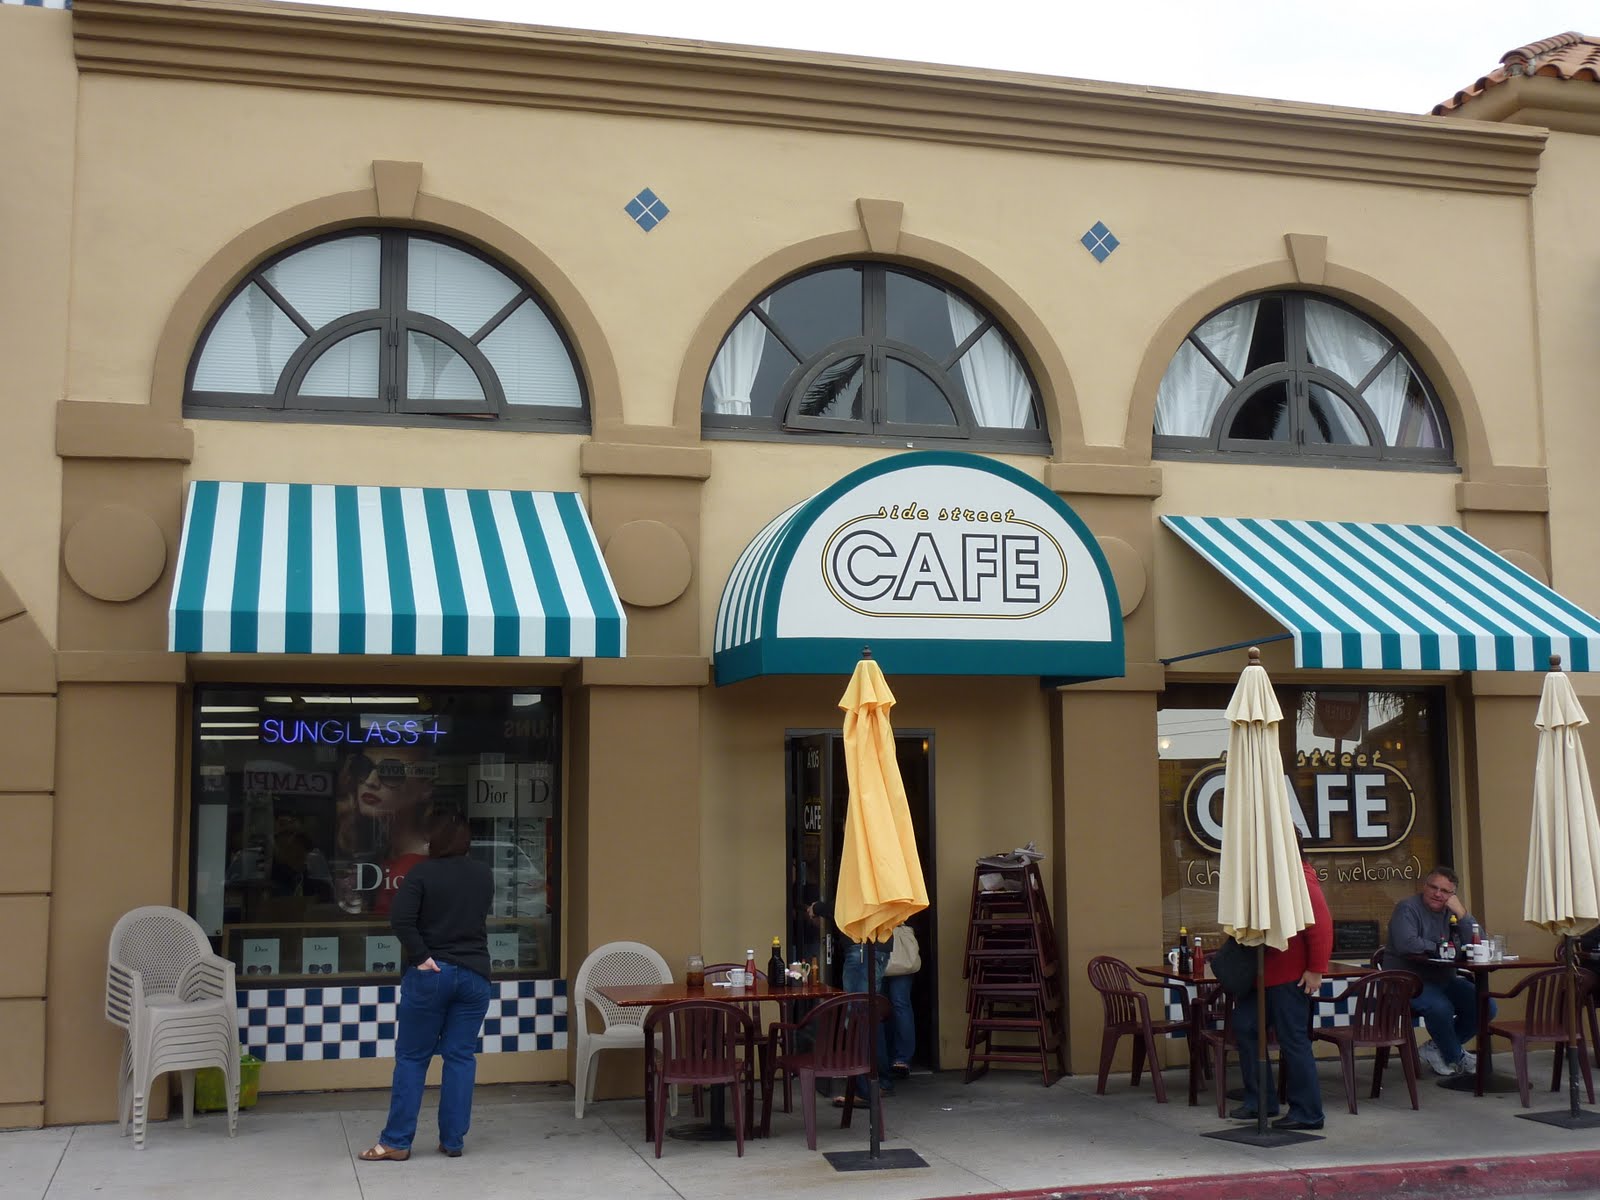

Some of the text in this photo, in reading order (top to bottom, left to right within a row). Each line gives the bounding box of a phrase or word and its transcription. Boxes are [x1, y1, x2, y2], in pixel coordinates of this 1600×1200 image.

[878, 502, 1015, 523] side street
[832, 529, 1041, 604] CAFE
[1296, 749, 1382, 767] street
[473, 779, 508, 804] Dior
[804, 805, 822, 830] CAFE
[352, 862, 405, 891] Di
[1337, 855, 1421, 881] welcome)
